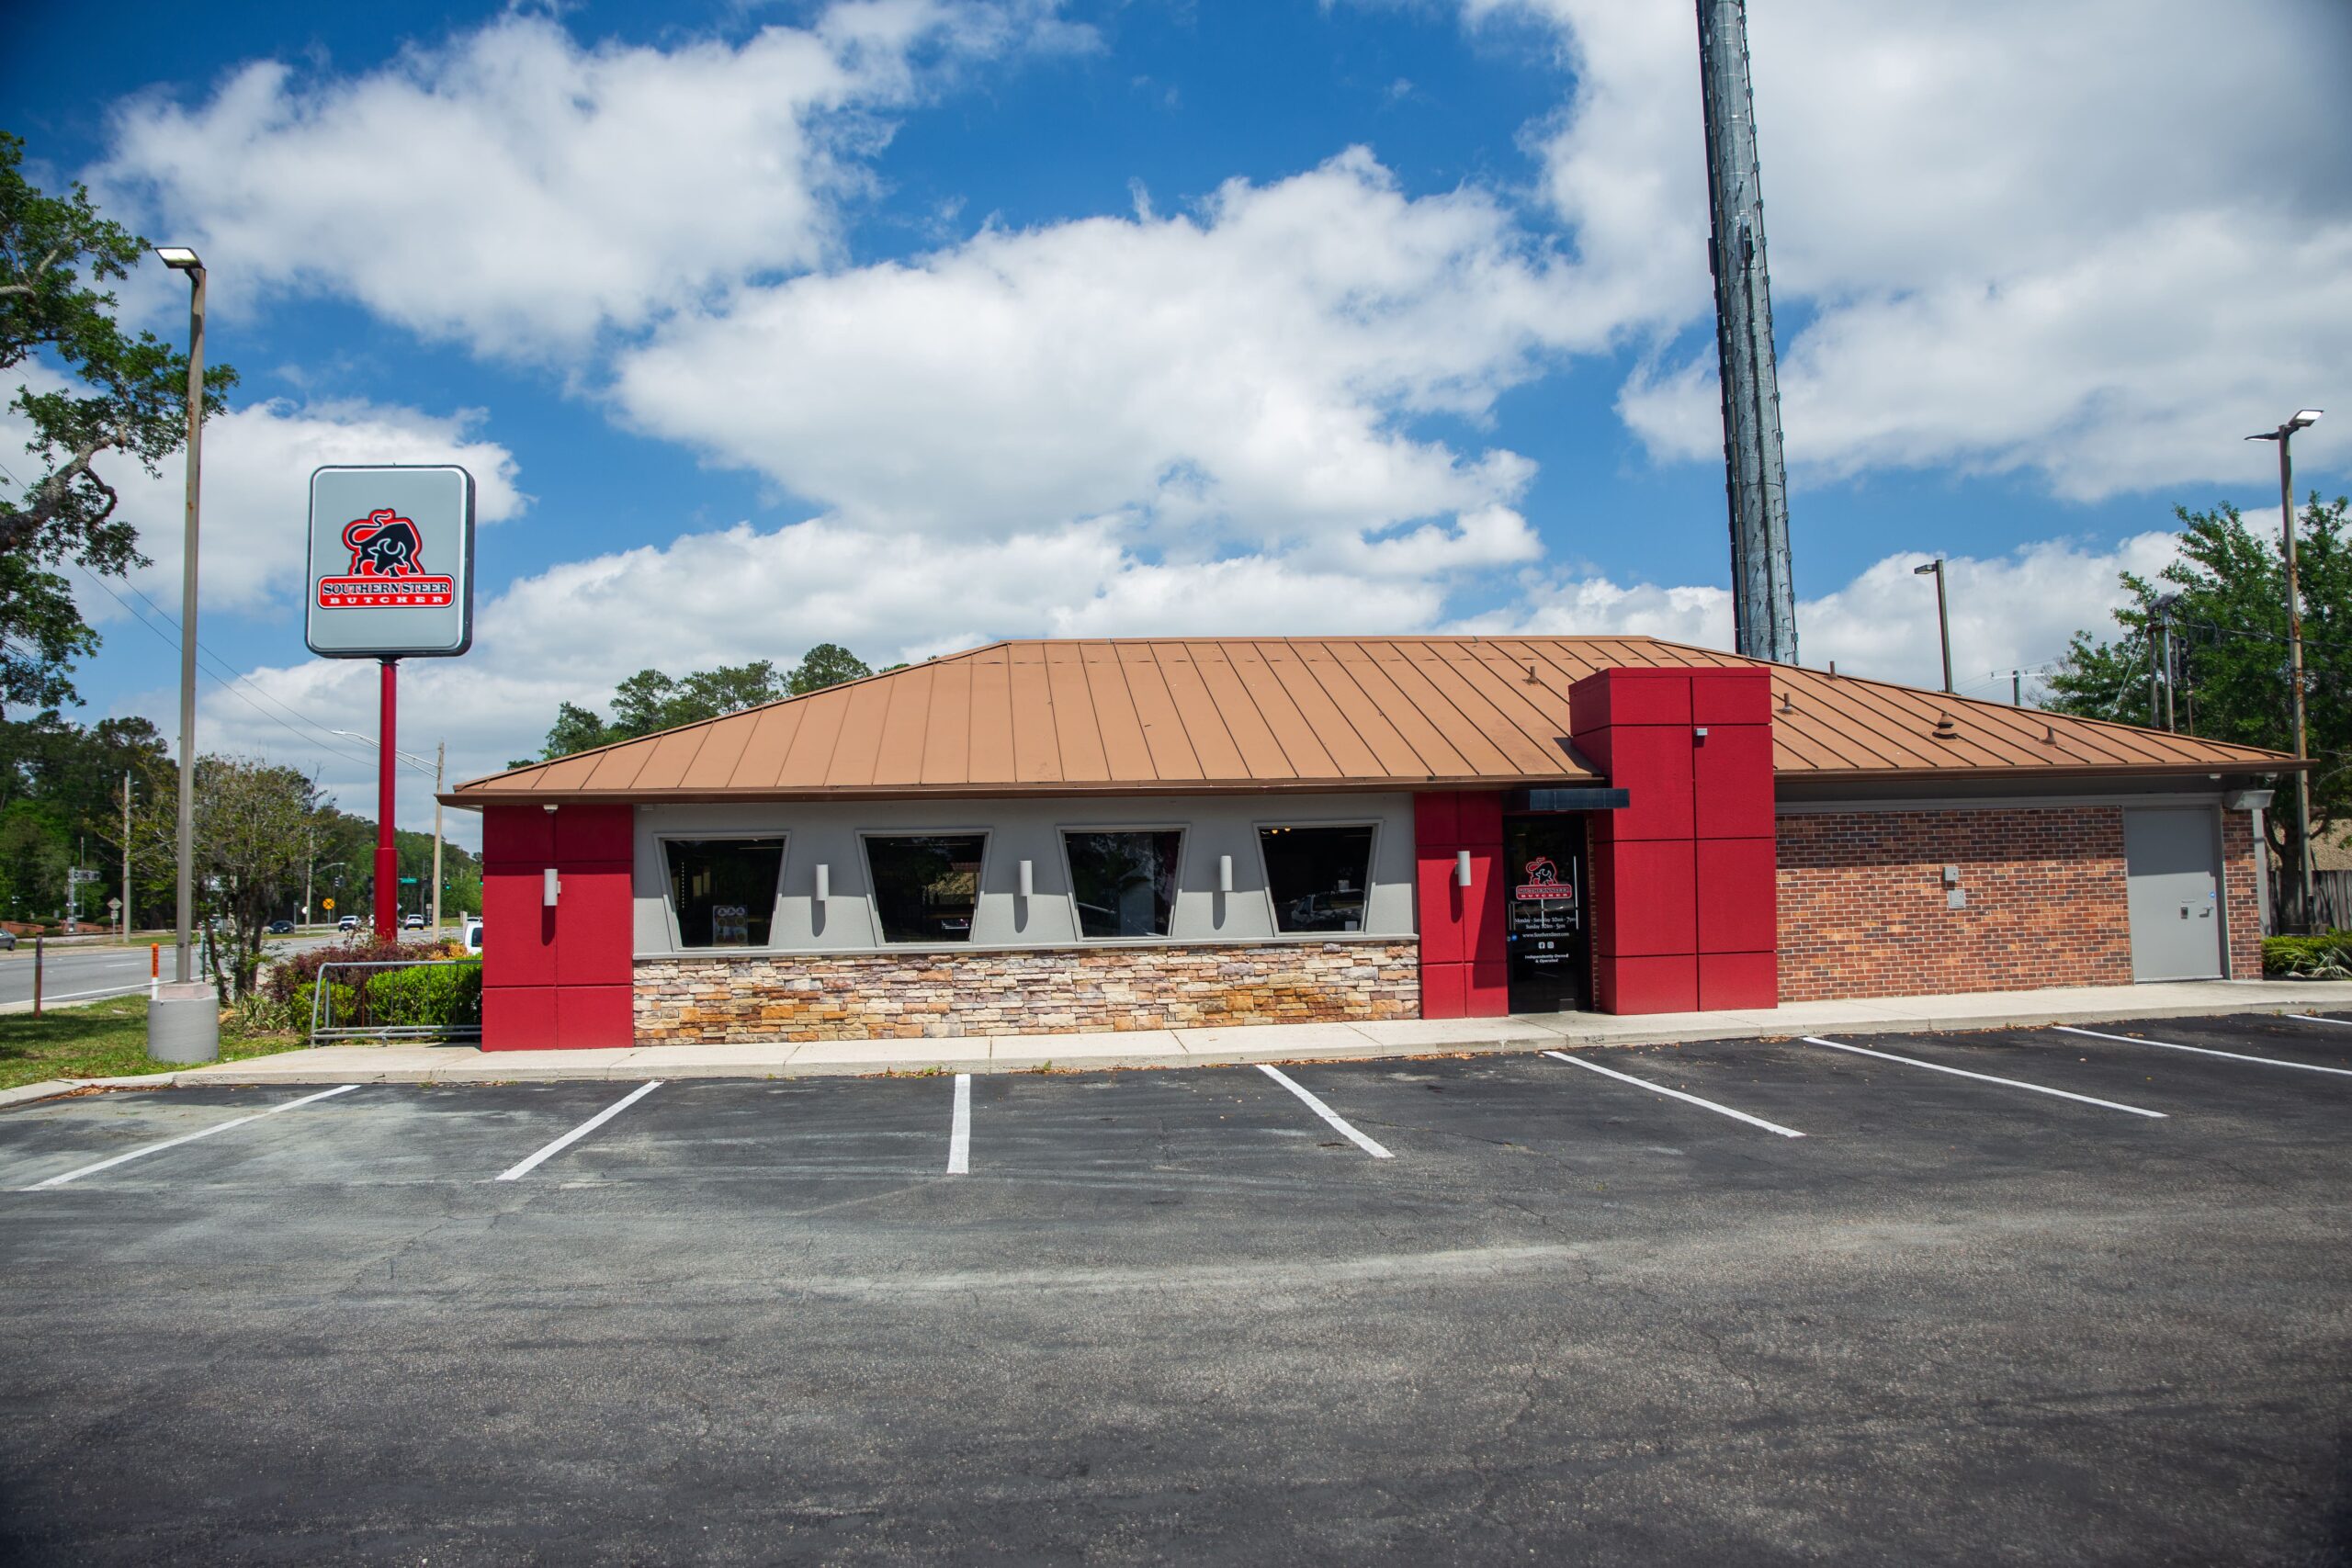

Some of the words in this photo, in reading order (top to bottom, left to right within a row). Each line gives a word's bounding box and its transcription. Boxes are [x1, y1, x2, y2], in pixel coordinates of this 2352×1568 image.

[323, 583, 400, 595] SOUTHERN
[401, 582, 450, 593] STEER
[329, 596, 443, 604] BUTCHER
